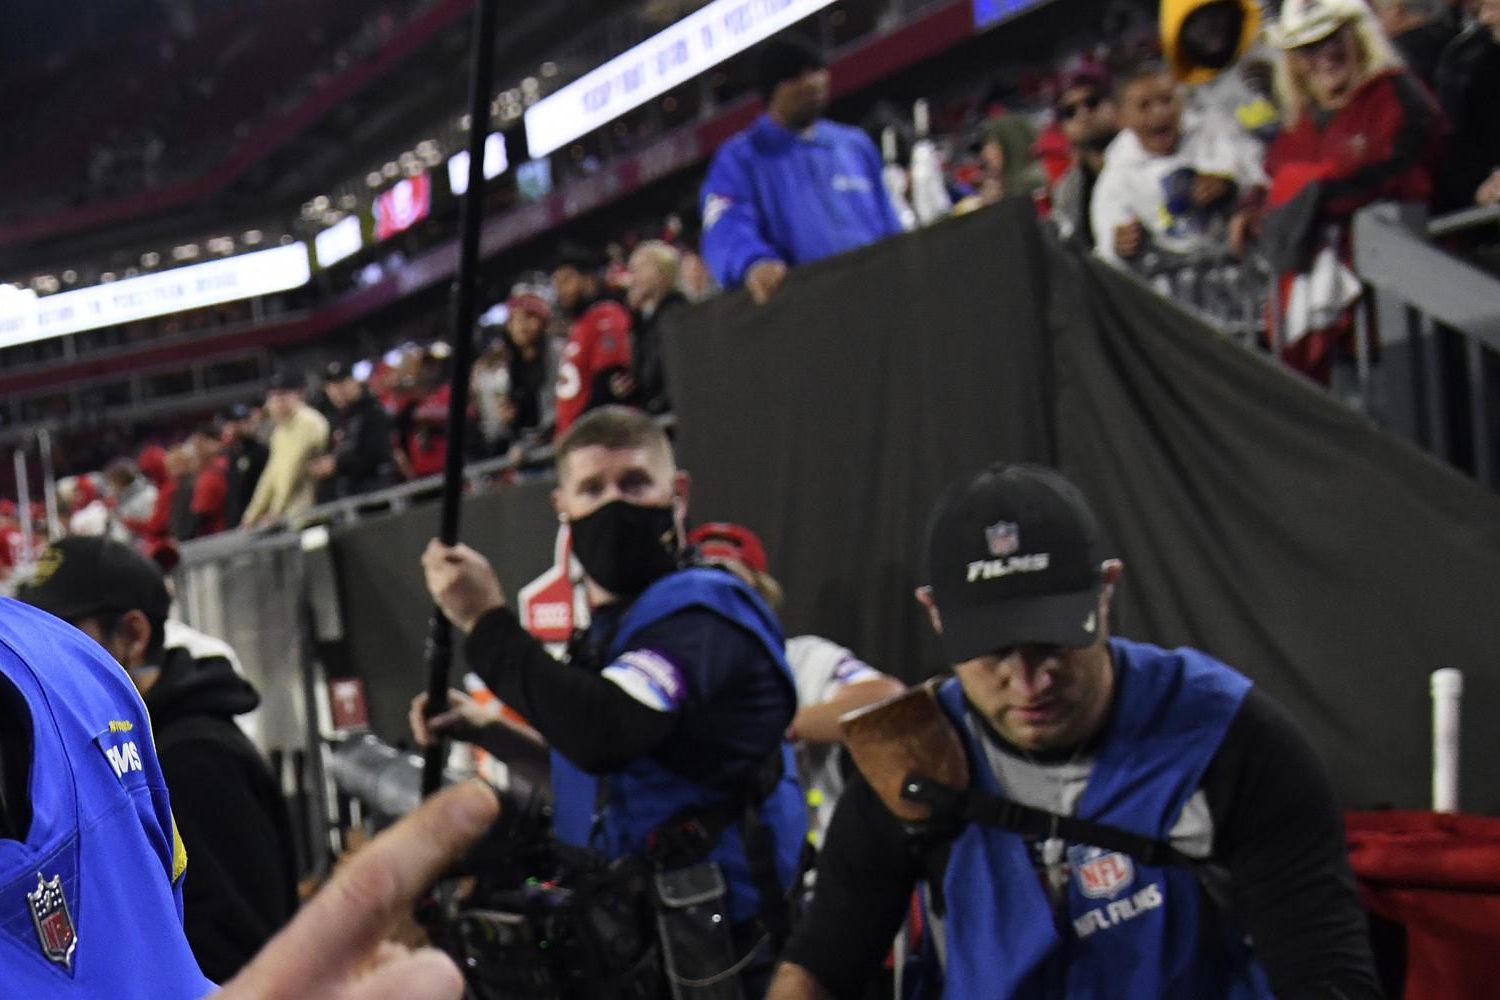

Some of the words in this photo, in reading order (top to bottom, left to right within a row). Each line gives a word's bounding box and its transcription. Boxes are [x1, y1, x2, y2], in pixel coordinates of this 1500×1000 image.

[966, 552, 1051, 582] FILMS
[1073, 908, 1111, 938] NFL
[1106, 883, 1163, 924] FILMS
